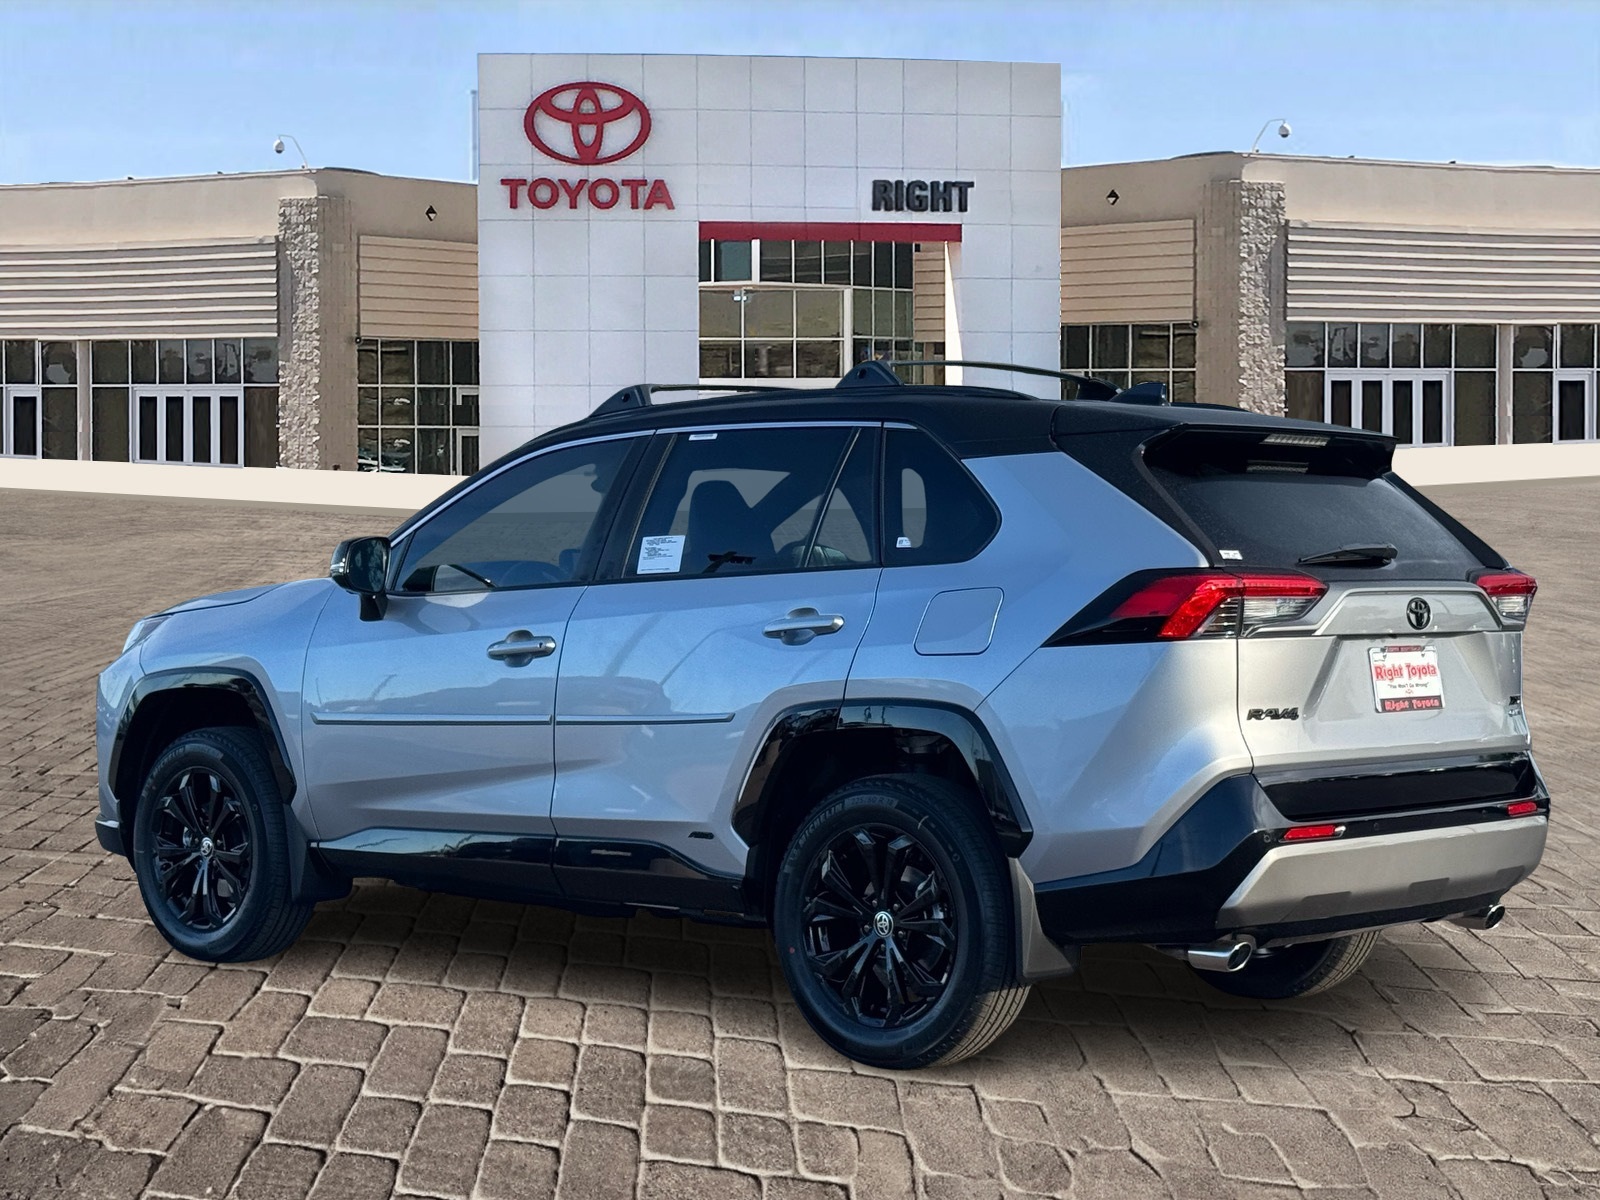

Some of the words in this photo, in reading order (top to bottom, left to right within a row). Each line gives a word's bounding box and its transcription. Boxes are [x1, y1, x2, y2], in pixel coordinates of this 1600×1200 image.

[500, 178, 675, 211] TOYOTA
[872, 179, 975, 213] RIGHT
[1374, 663, 1403, 682] Right
[1405, 662, 1437, 679] Toyota
[1247, 707, 1299, 720] RAV4
[1385, 700, 1409, 711] Right
[1412, 698, 1440, 709] Toyota
[798, 802, 843, 847] MICHELIN
